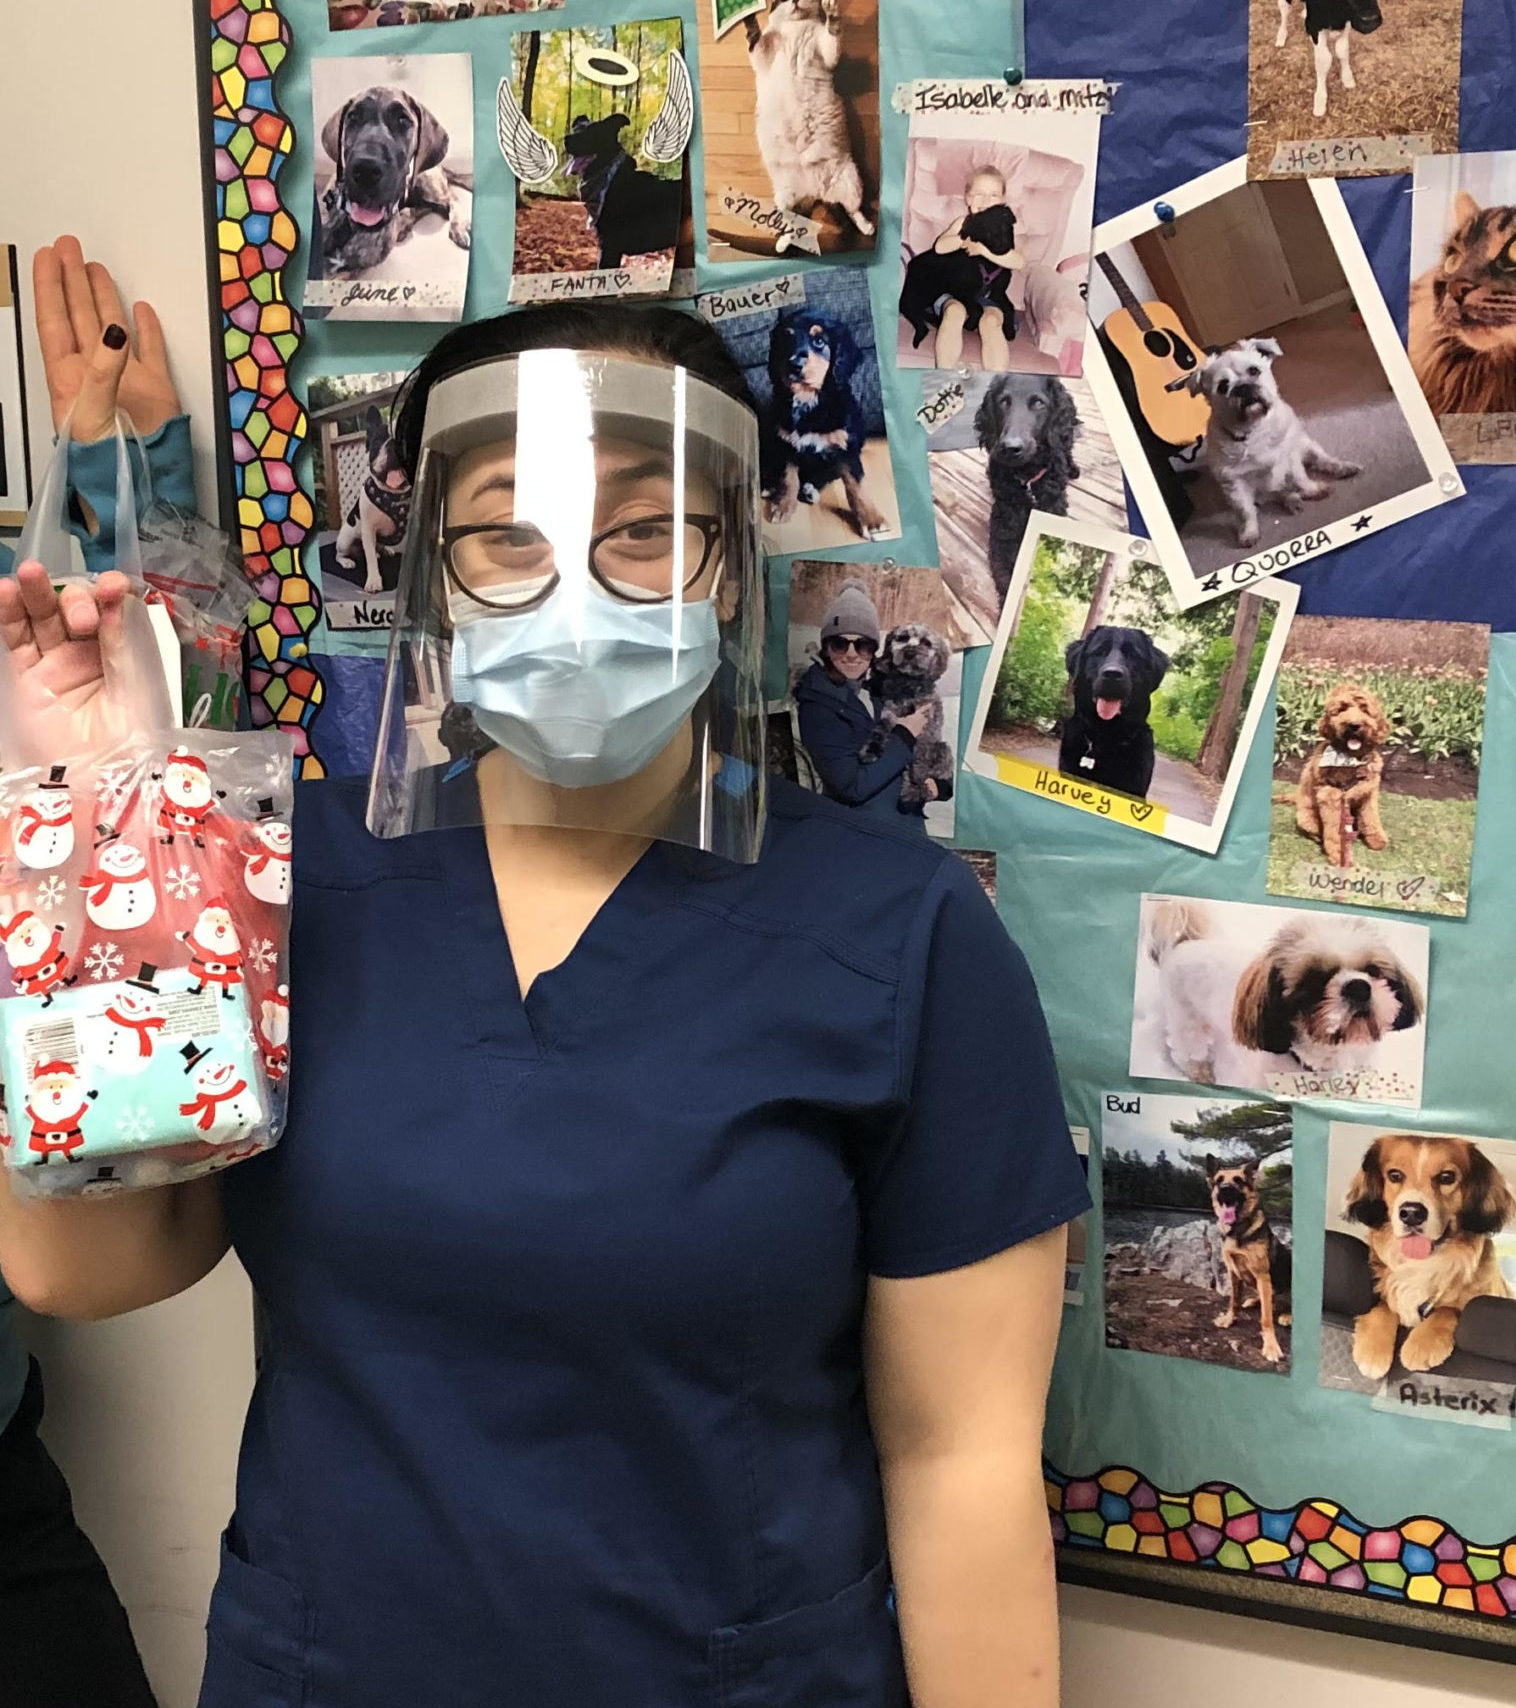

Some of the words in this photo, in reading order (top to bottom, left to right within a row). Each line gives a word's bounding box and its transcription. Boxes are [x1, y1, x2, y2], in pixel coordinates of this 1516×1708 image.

[915, 84, 1007, 110] Isabelle
[1014, 89, 1052, 109] and
[735, 198, 795, 238] Molly
[341, 283, 399, 306] June
[551, 277, 606, 292] FANTA
[710, 290, 775, 317] Bauer
[917, 384, 964, 423] Dottie
[1232, 530, 1332, 583] QUORRA
[1035, 770, 1111, 814] Harvey
[1294, 1077, 1360, 1095] Harley
[1106, 1095, 1140, 1114] Bud
[1400, 1383, 1497, 1415] Asterix
